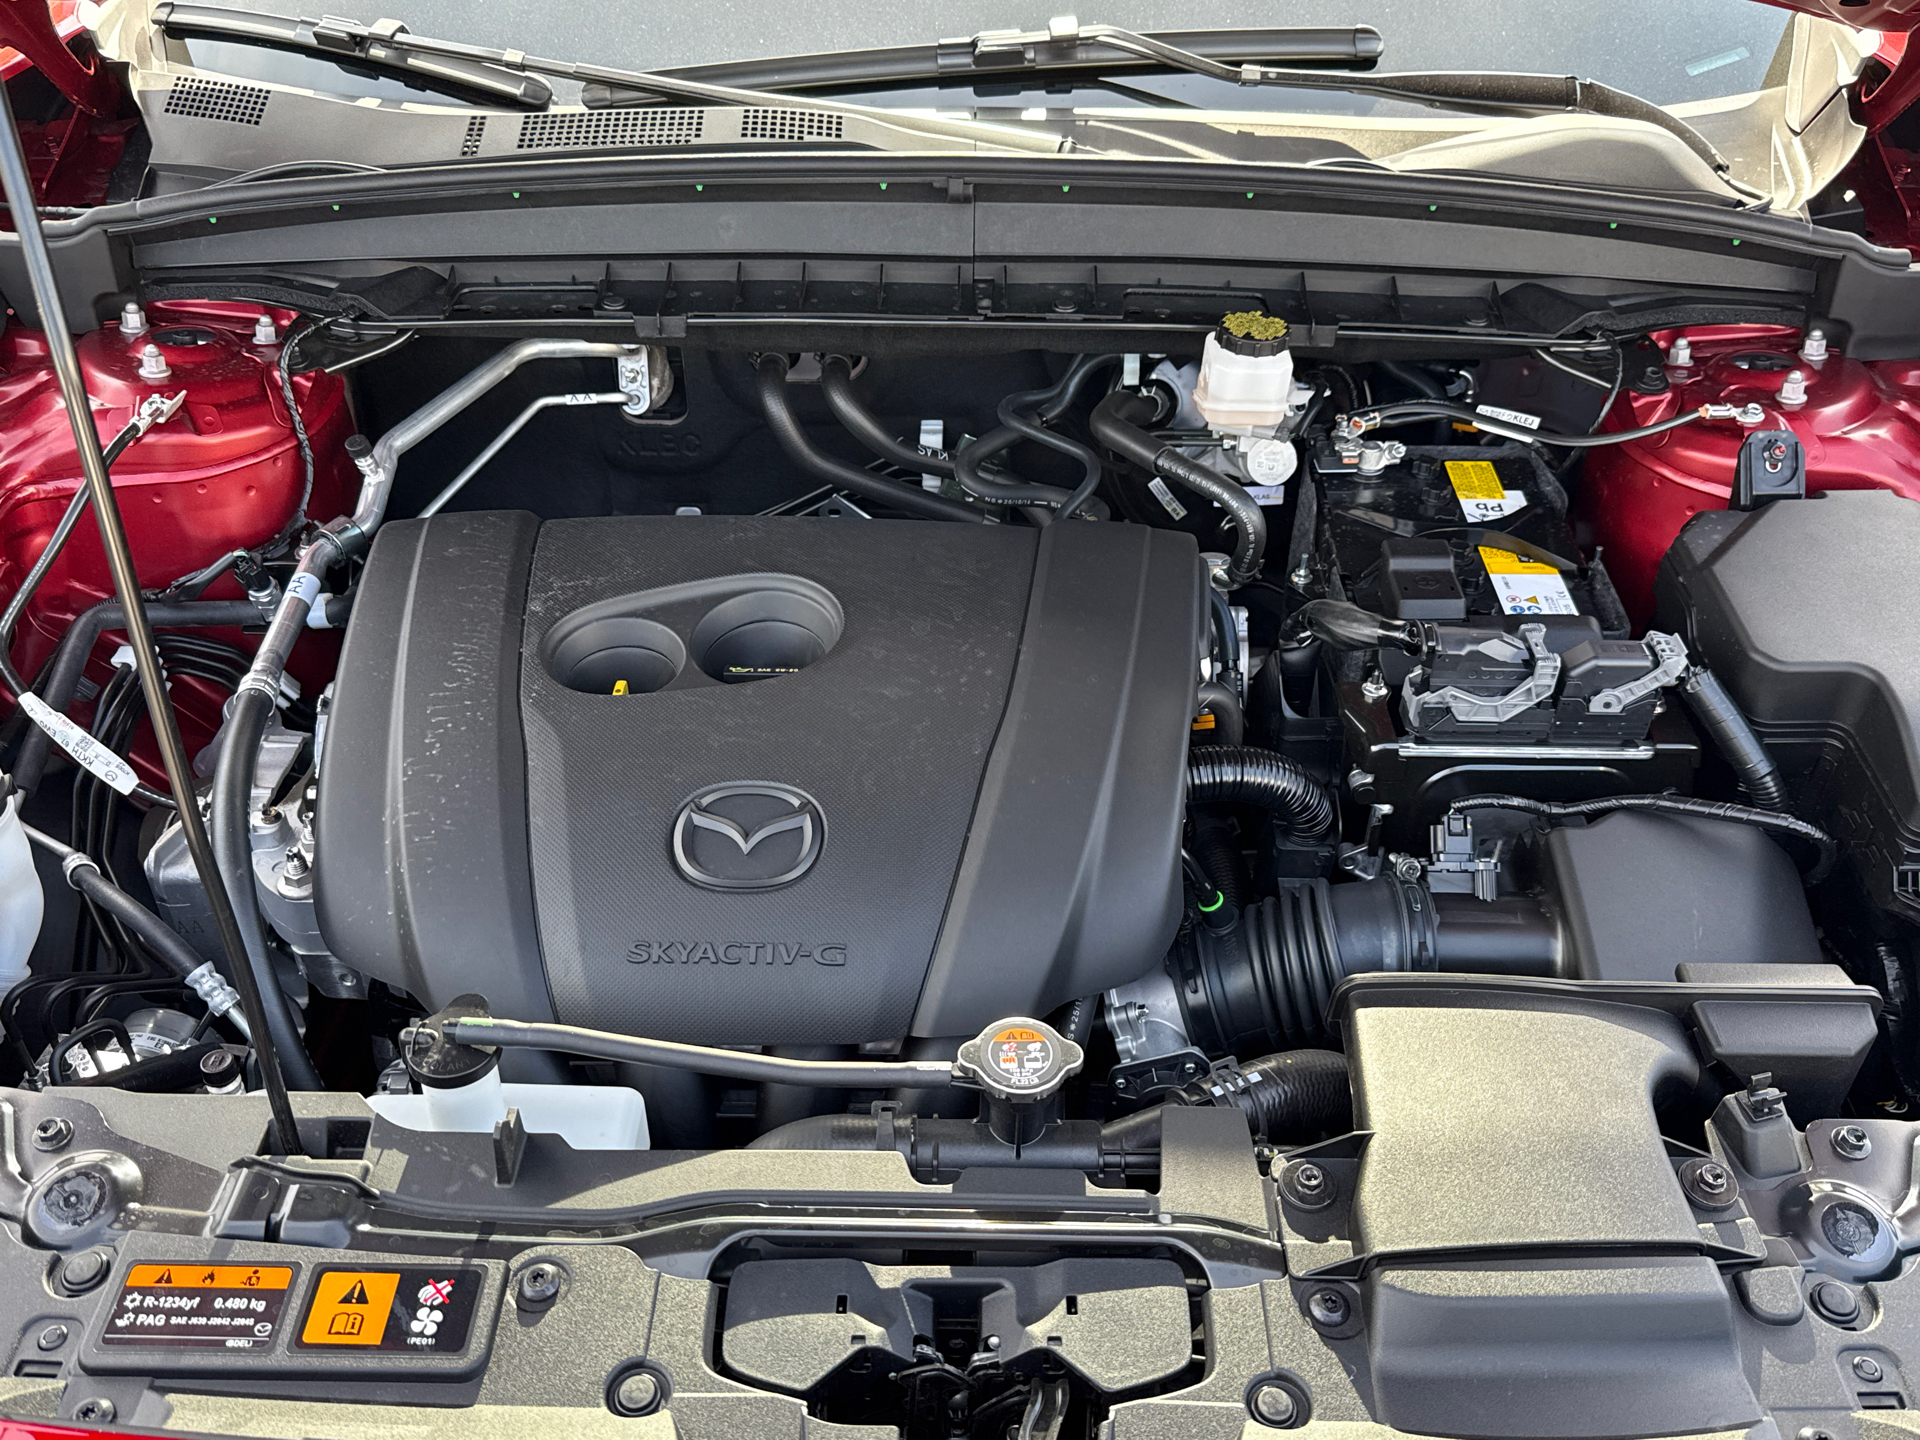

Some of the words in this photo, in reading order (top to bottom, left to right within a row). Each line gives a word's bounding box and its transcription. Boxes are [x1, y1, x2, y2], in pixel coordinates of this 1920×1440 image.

[1512, 414, 1535, 427] KLEJ
[1475, 503, 1504, 513] Pb
[287, 571, 306, 595] AA
[72, 746, 94, 767] KKTH
[626, 940, 848, 966] SKYACTIV-G
[143, 1295, 200, 1311] R-1234yf
[214, 1297, 248, 1309] 0.480
[250, 1298, 266, 1312] kg
[136, 1314, 166, 1326] PAG
[170, 1316, 187, 1324] SAE
[407, 1337, 435, 1345] (PE01)
